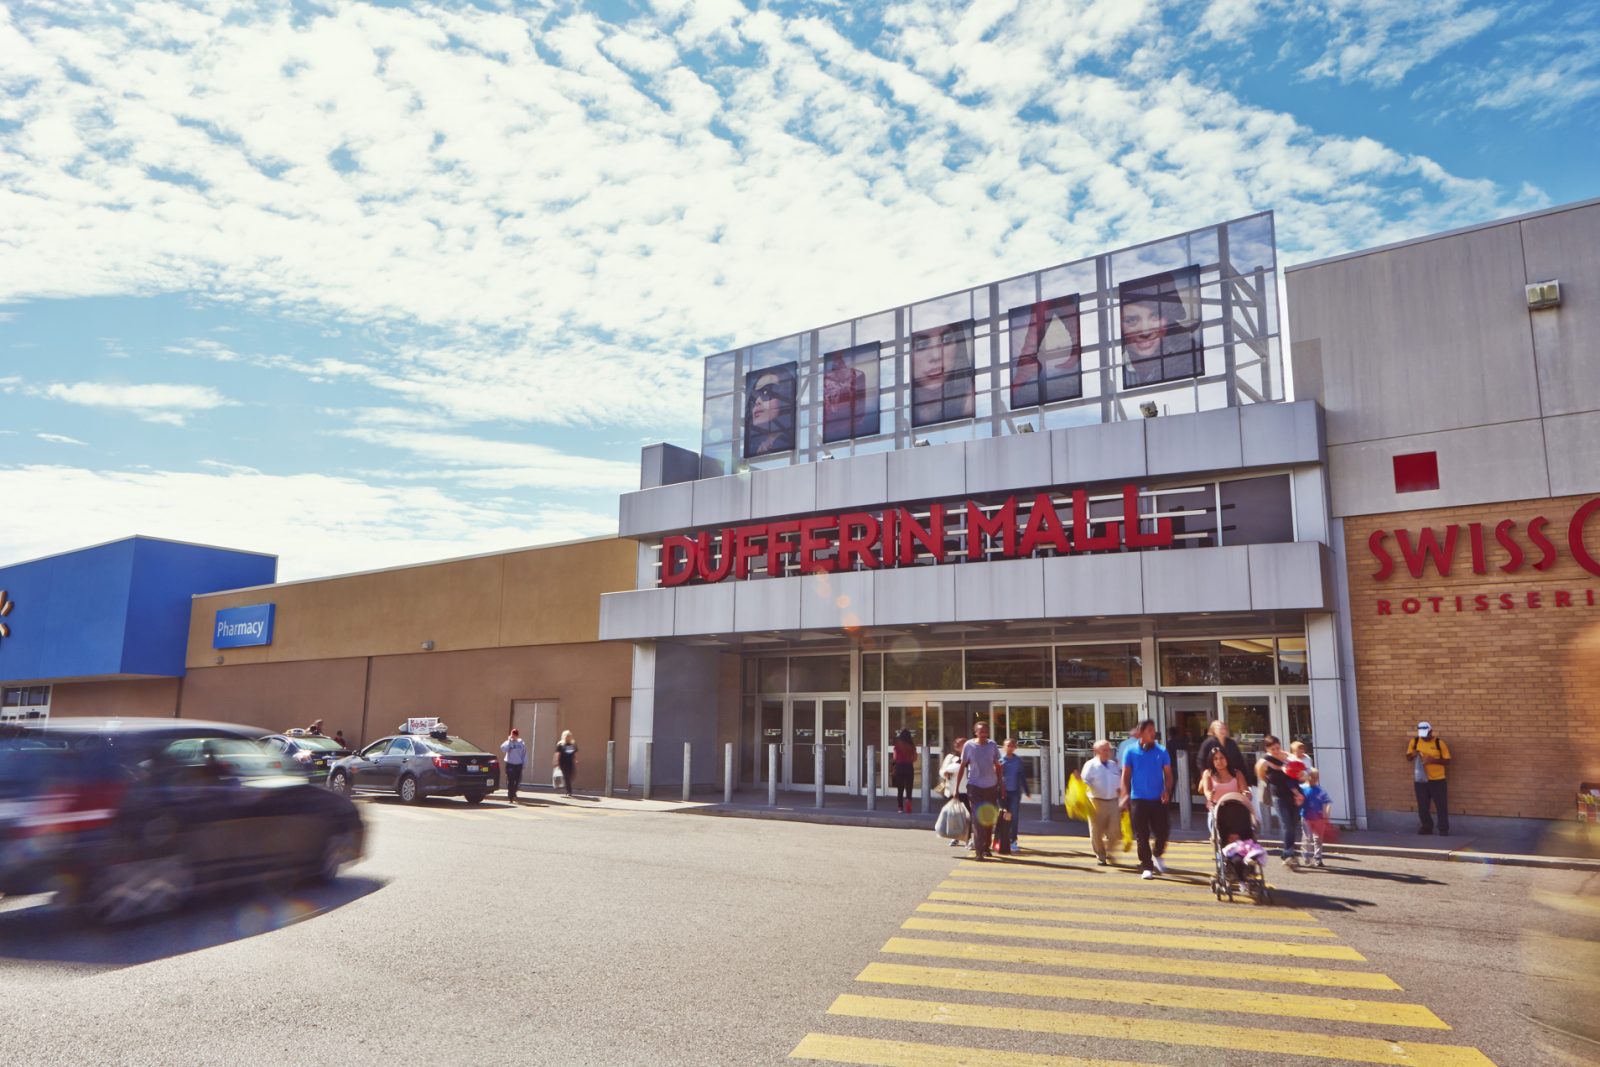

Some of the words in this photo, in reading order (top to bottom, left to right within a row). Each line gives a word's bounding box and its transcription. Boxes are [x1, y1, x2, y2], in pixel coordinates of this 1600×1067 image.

[661, 503, 945, 587] DUFFERIN
[967, 484, 1174, 560] MALL
[1377, 589, 1595, 616] ROTISSERI
[217, 620, 265, 639] Pharmacy
